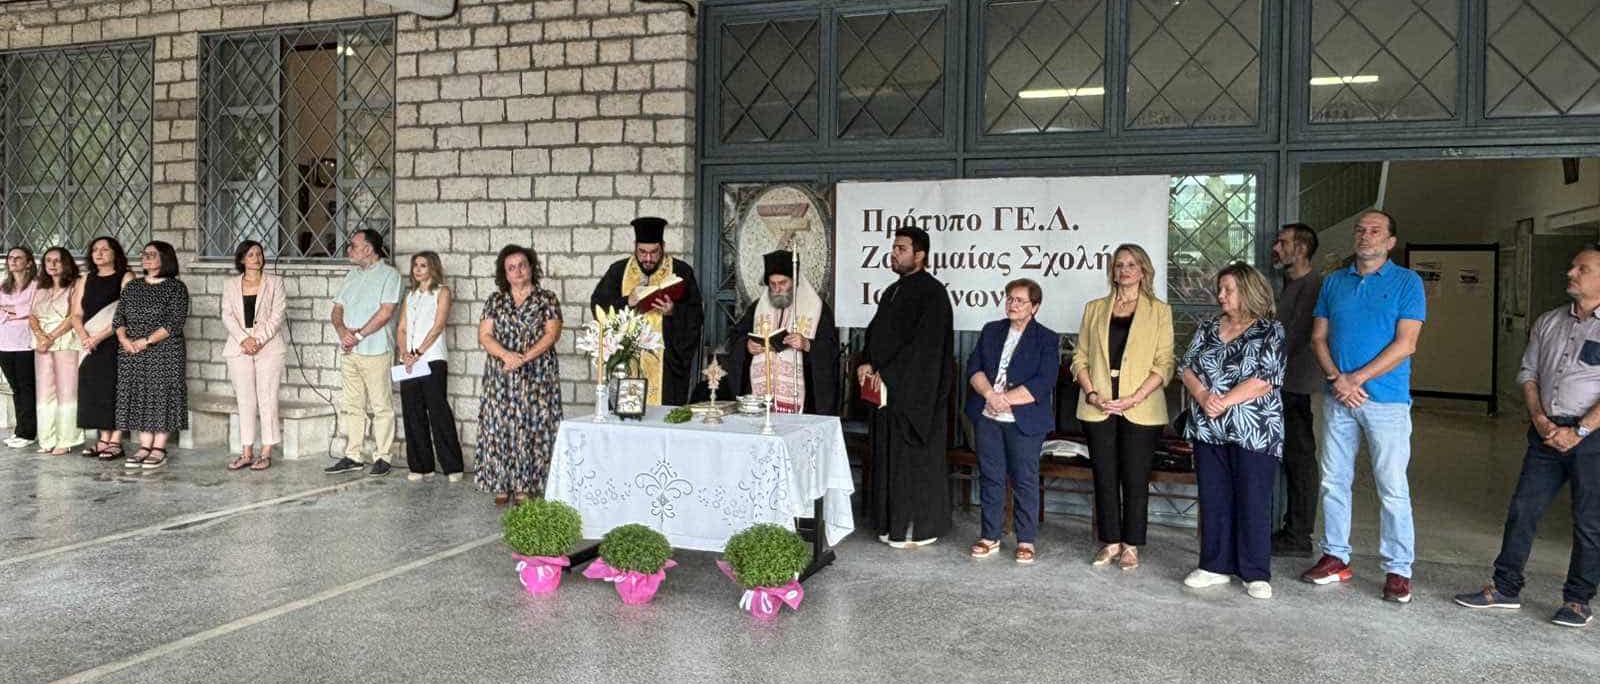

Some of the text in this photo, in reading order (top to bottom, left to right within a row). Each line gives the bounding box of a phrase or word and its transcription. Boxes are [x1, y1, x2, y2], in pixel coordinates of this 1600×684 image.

[862, 205, 1079, 239] Πρότυπο ΓΕ.Λ.
[861, 244, 1112, 277] Ζμαίας Σχολή
